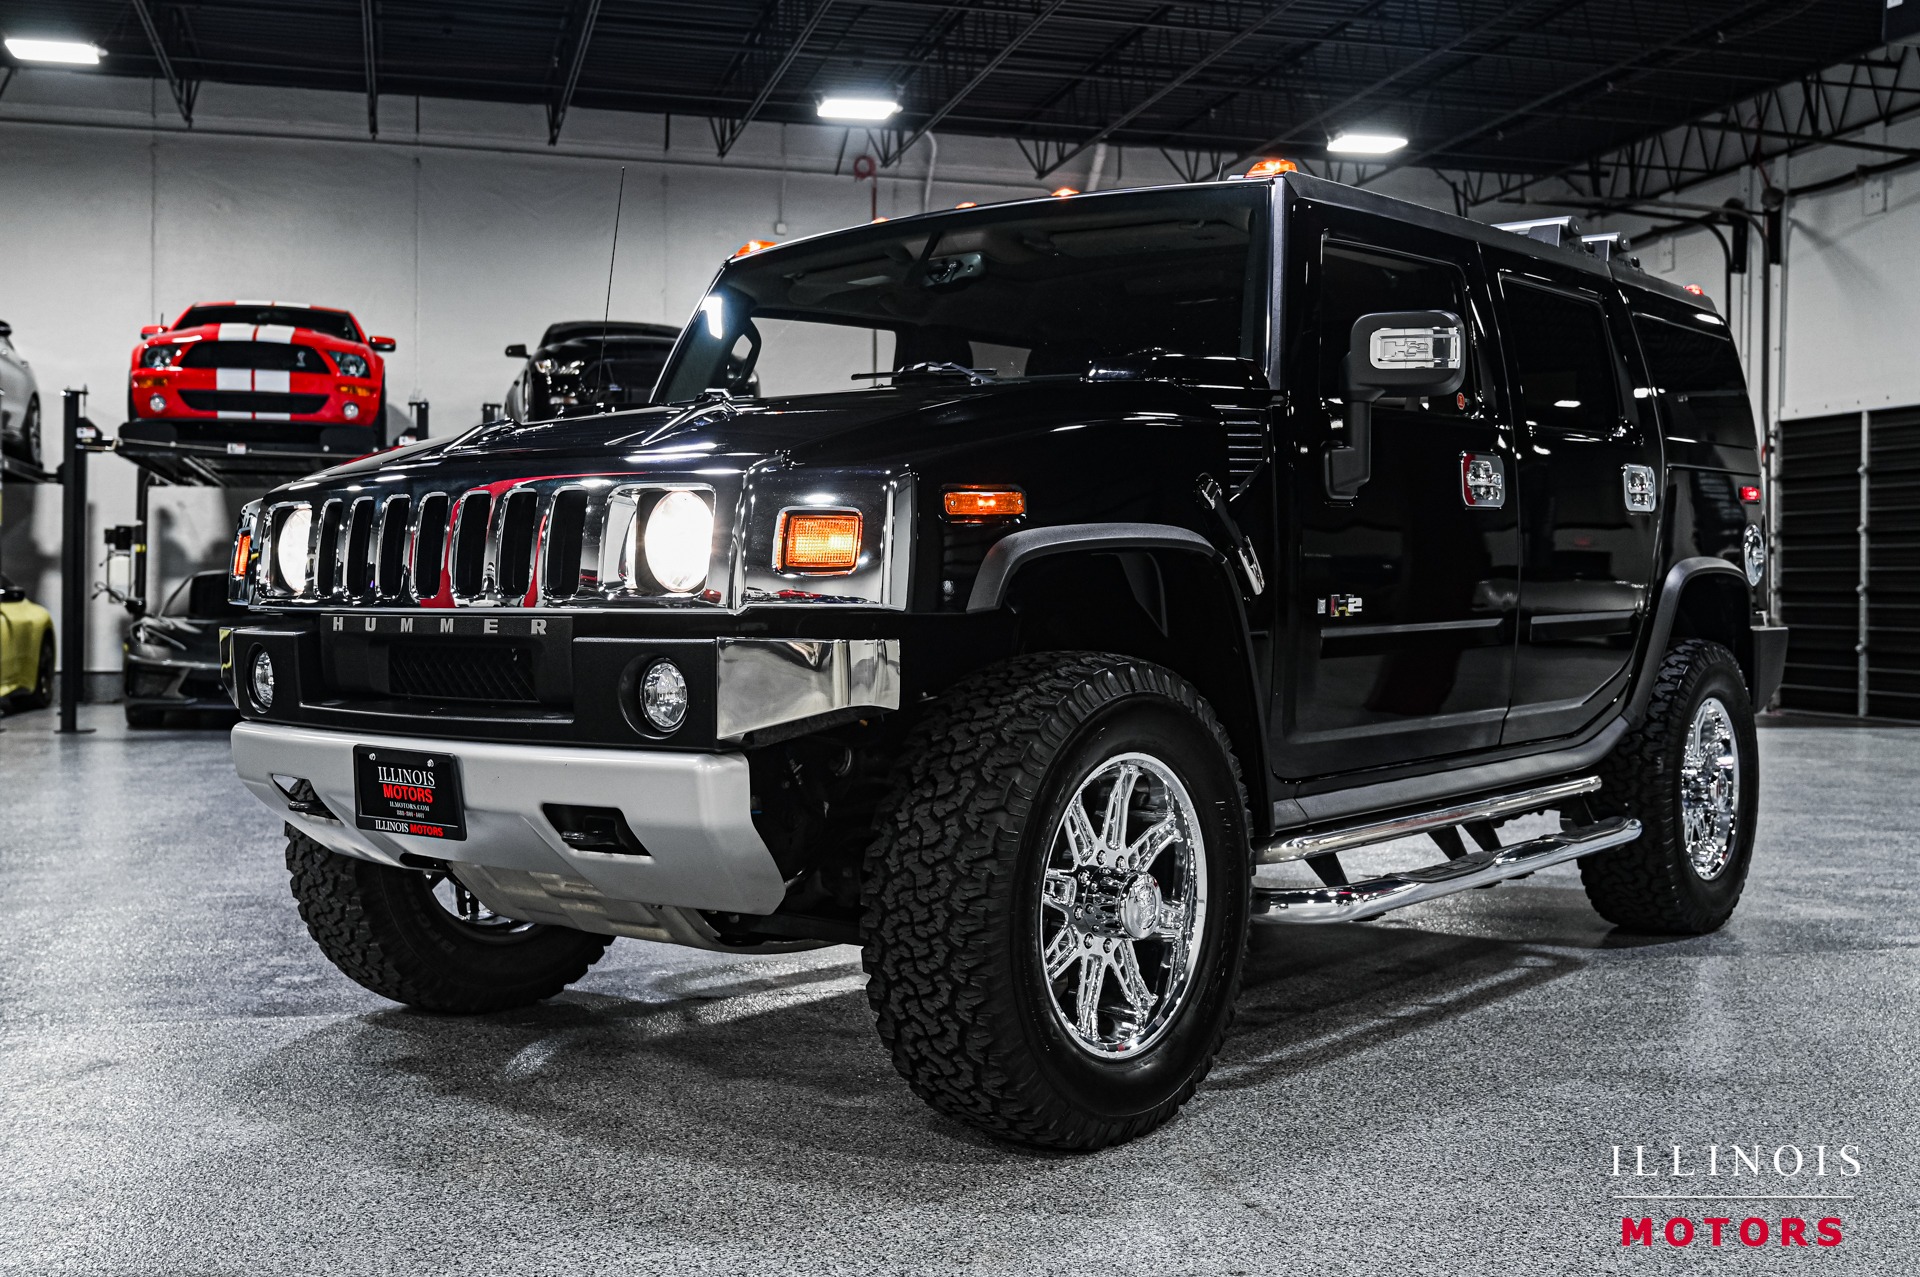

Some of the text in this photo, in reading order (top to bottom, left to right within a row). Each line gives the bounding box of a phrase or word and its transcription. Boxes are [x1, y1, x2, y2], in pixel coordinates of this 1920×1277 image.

[332, 616, 548, 635] HUMMER
[378, 766, 435, 786] ILLINOIS
[383, 784, 433, 803] MOTORS
[375, 820, 444, 837] ILLINOIS MOTORS
